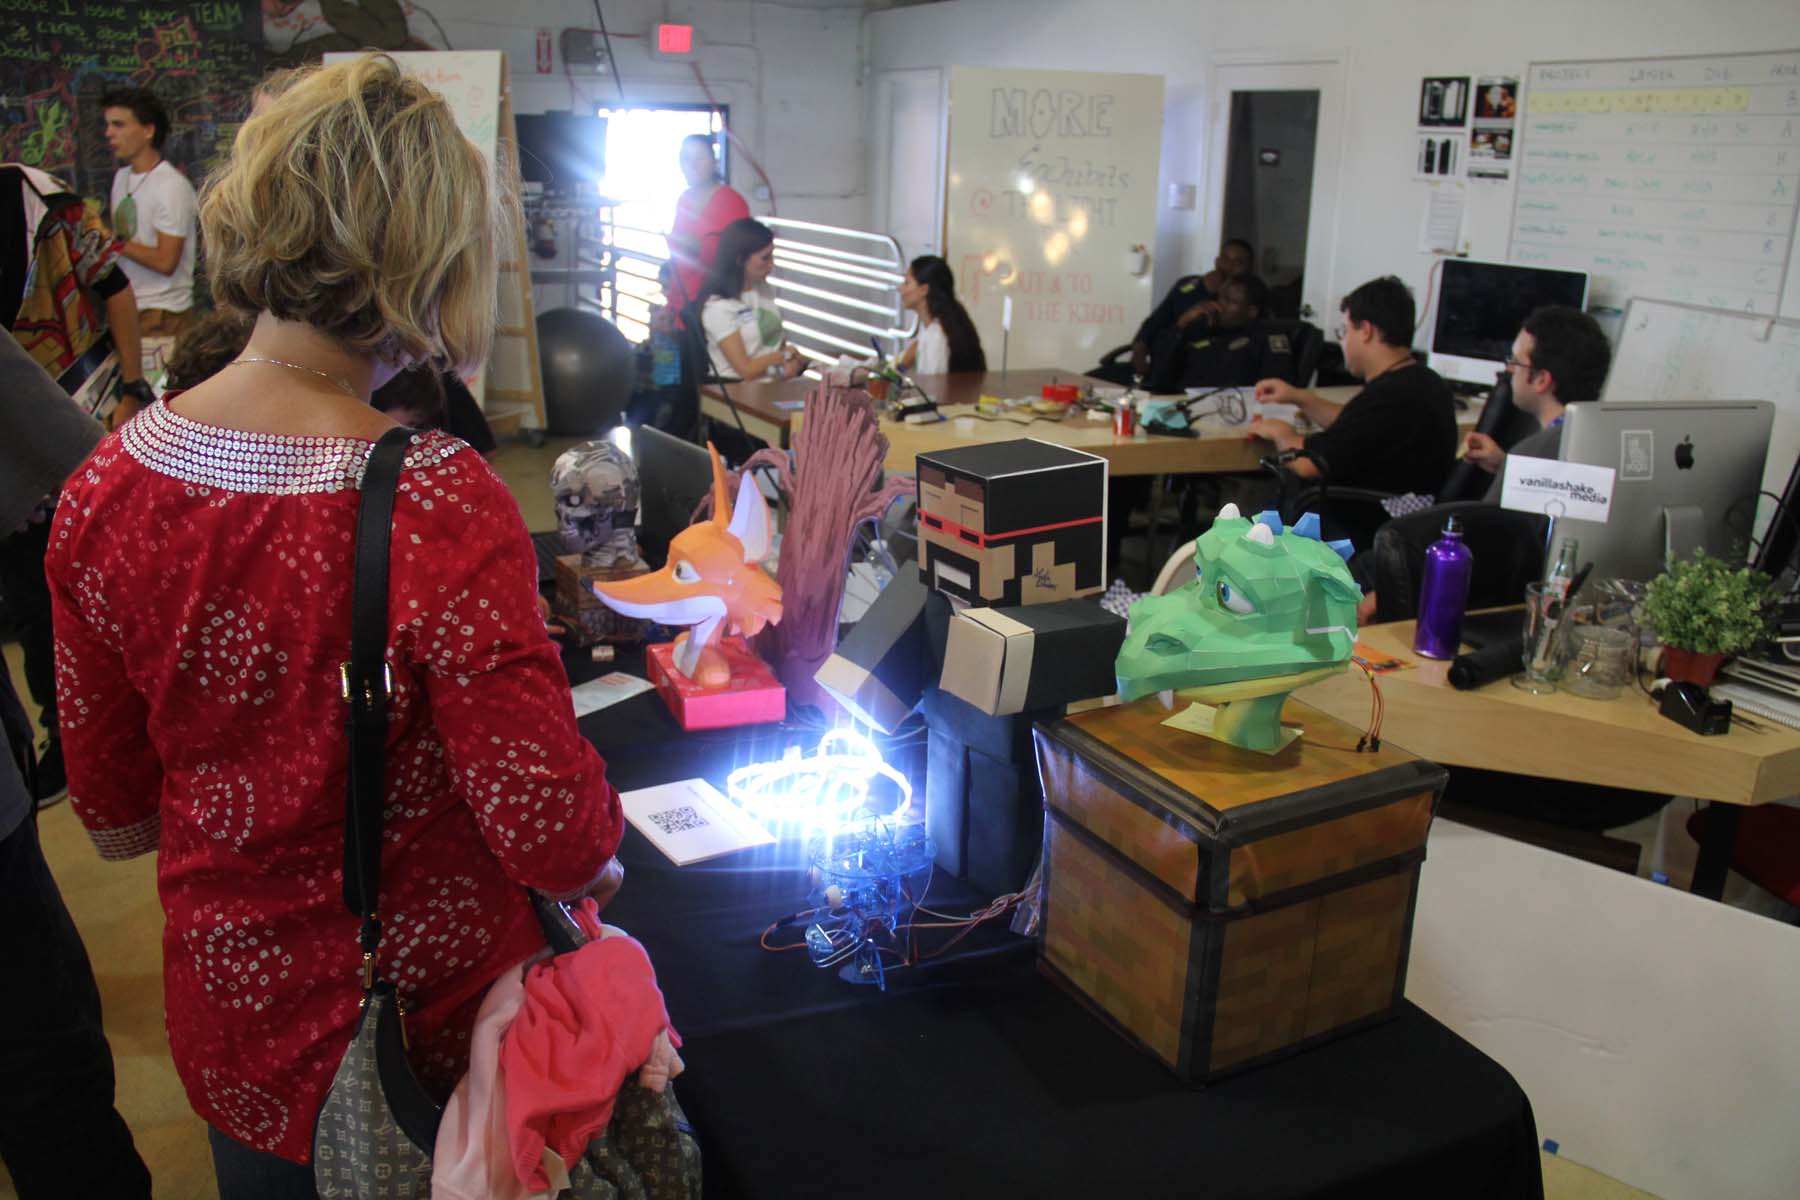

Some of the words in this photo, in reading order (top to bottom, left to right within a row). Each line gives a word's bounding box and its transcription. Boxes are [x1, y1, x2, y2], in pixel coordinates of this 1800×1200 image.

[189, 2, 242, 24] TEAM
[990, 87, 1115, 139] MORE
[1519, 477, 1594, 494] vanillashake
[1569, 491, 1608, 505] media
